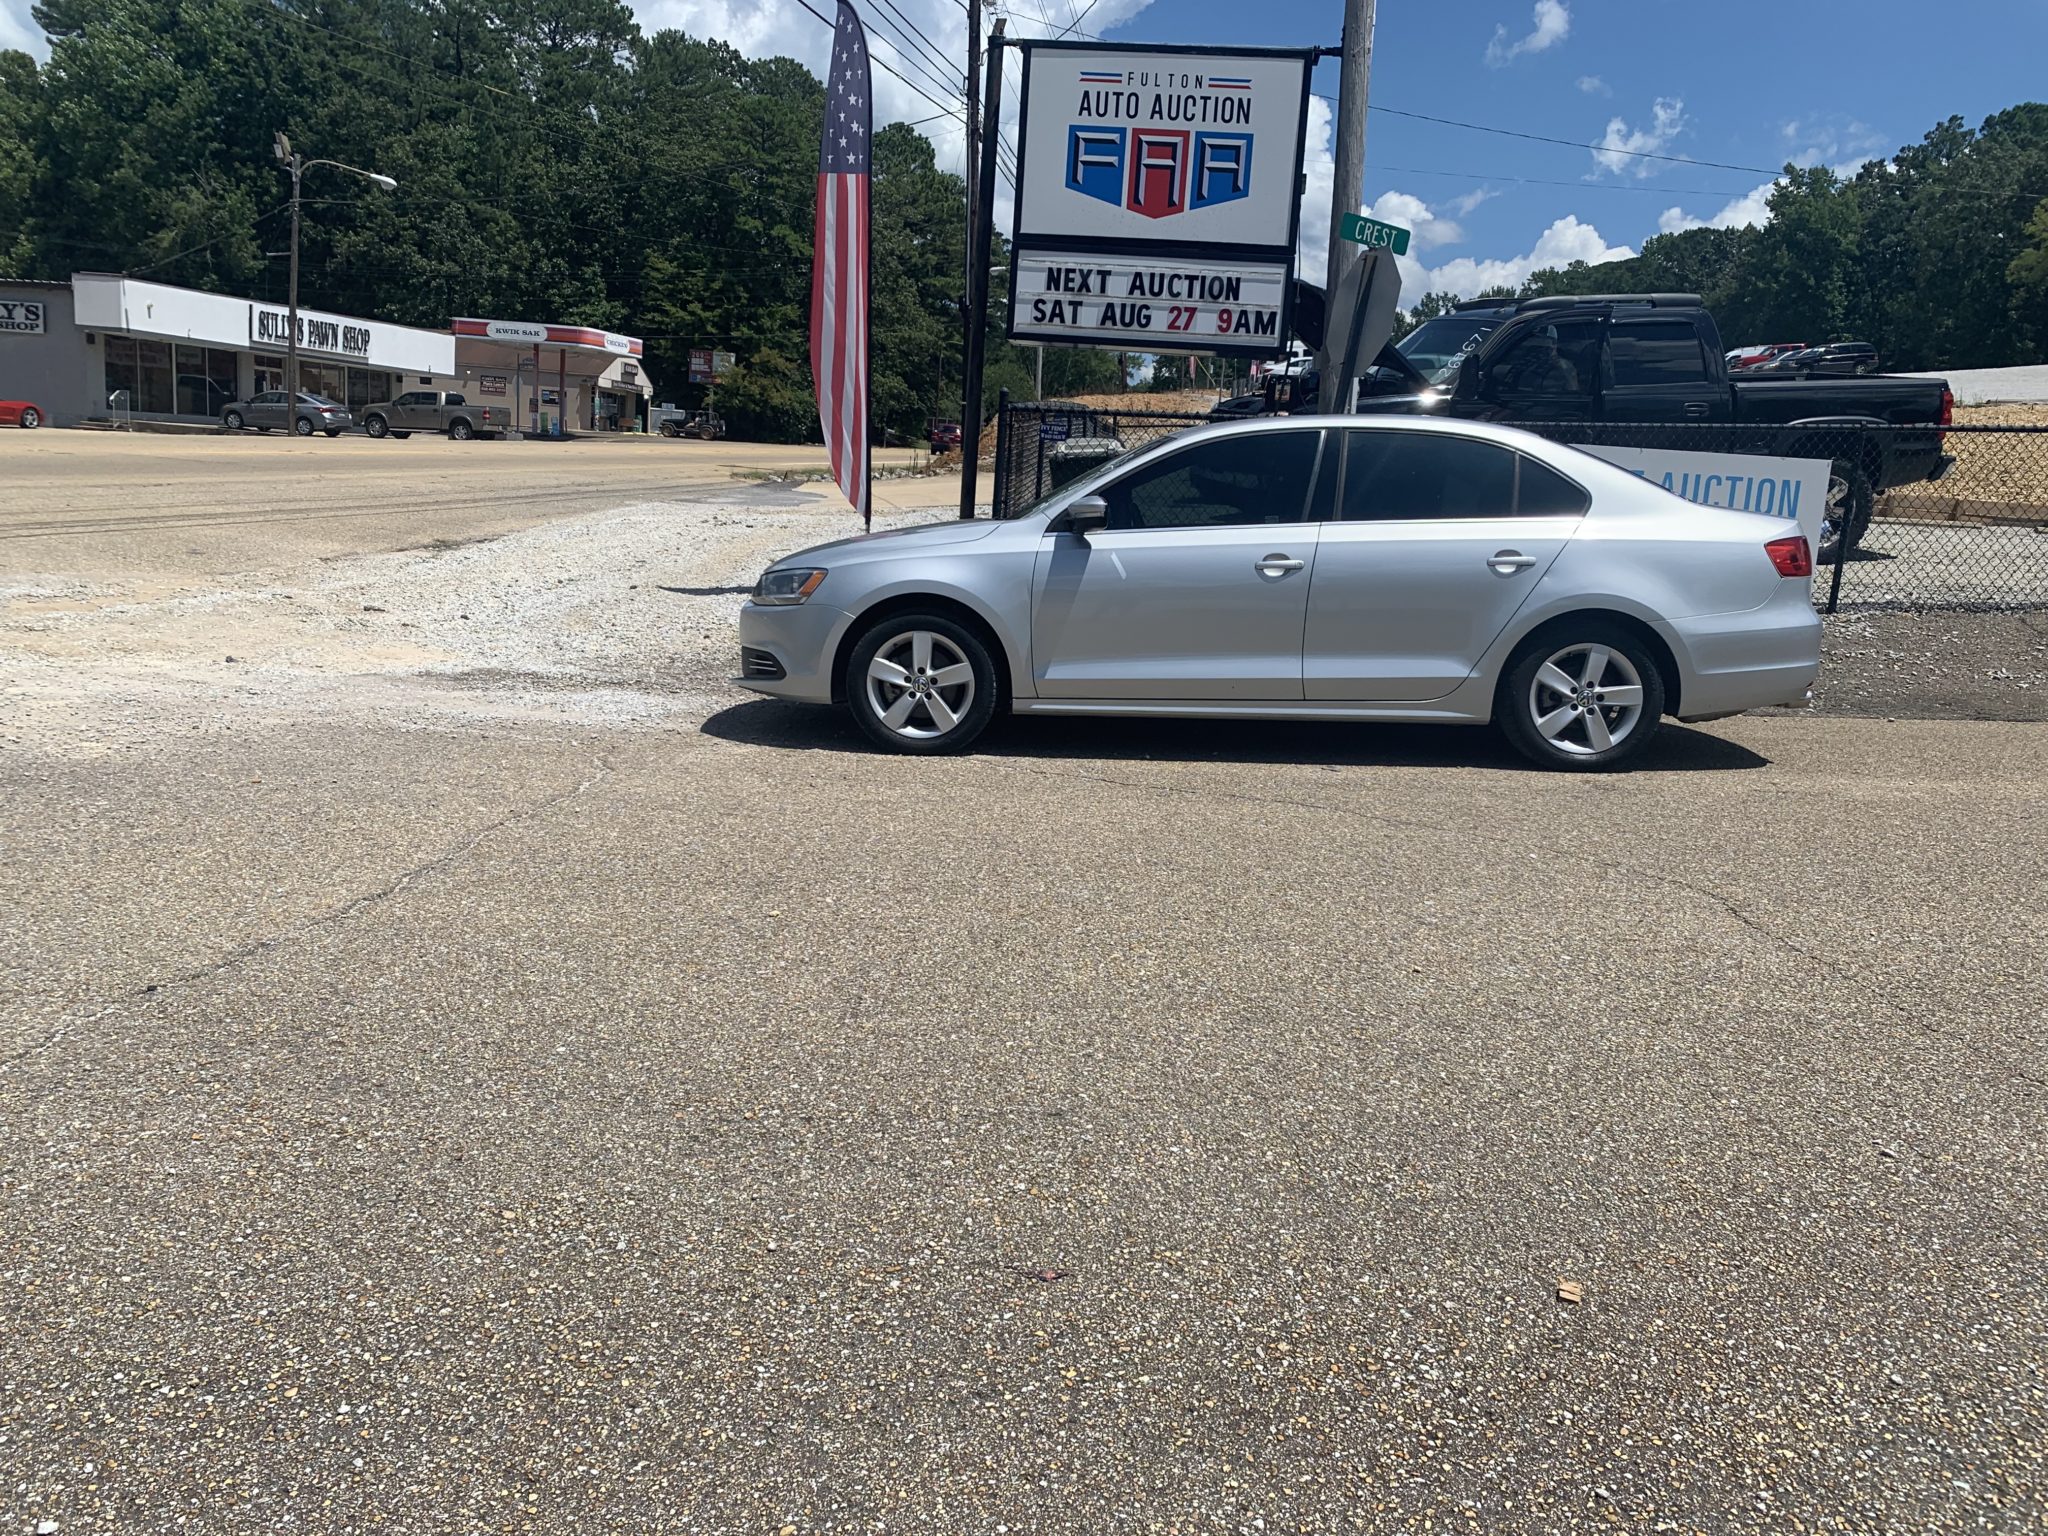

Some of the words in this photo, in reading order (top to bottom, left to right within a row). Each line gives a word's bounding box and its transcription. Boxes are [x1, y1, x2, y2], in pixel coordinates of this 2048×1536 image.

[1127, 71, 1203, 89] FULTON
[1078, 90, 1140, 119] AUTO
[1150, 93, 1252, 124] AUCTION
[1355, 220, 1397, 247] CREST
[1046, 266, 1112, 295] NEXT
[1128, 271, 1242, 302] AUCTION
[0, 302, 40, 321] Y'S
[1033, 298, 1083, 325] SAT
[1099, 302, 1152, 329] AUG
[1167, 305, 1198, 331] 27
[1217, 308, 1278, 336] 9AM
[259, 310, 304, 343] SULLS
[308, 318, 340, 348] PAWN
[343, 324, 371, 353] SHOP
[495, 327, 520, 335] KWIK
[522, 329, 541, 337] SAK
